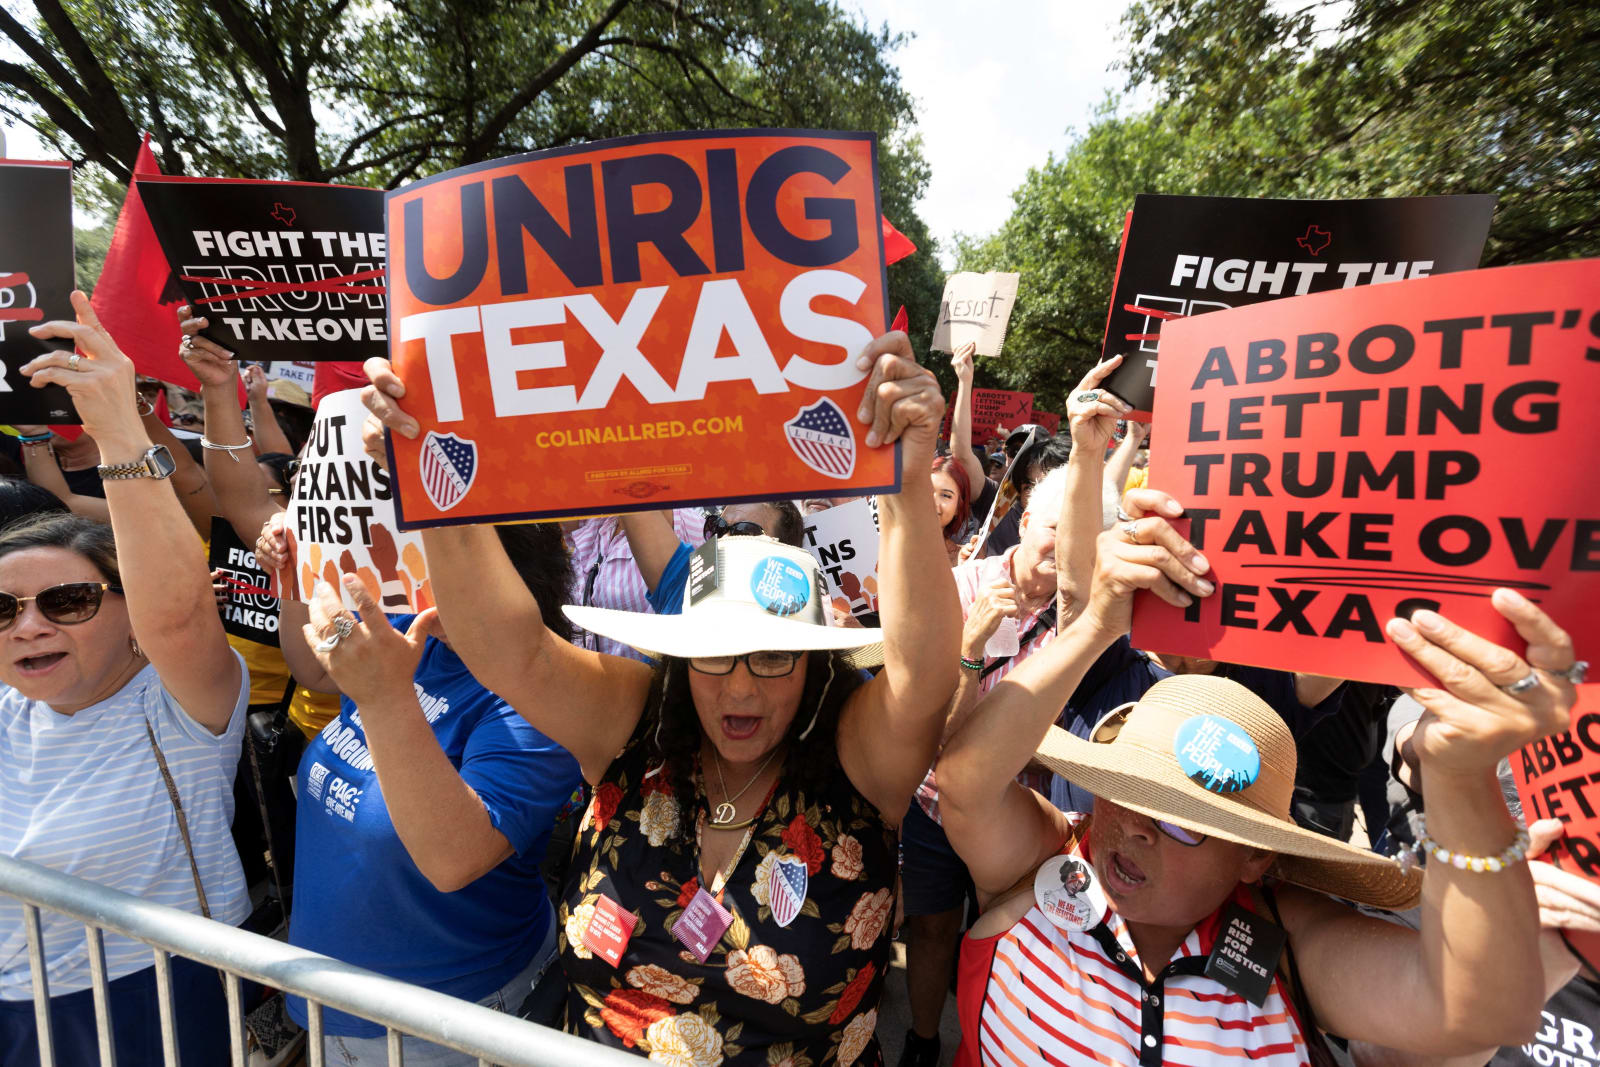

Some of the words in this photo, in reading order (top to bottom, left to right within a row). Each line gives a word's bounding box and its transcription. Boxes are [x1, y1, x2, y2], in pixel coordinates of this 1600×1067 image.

[403, 145, 860, 305] UNRIG
[192, 230, 304, 257] FIGHT
[312, 232, 386, 257] THE
[183, 264, 387, 312] TRUM
[1170, 254, 1328, 295] FIGHT
[224, 318, 388, 341] TAKEOVE
[400, 269, 874, 423] TEXAS
[280, 368, 305, 380] TAKE
[1187, 380, 1561, 442] LETTING
[307, 415, 347, 458] PUT
[535, 415, 743, 448] COLINALLRED.COM
[795, 428, 846, 447] LULAC
[292, 460, 392, 500] EXANS
[431, 443, 463, 488] LULAC
[1184, 450, 1481, 500] TRUMP
[297, 506, 374, 545] FIRST
[1183, 508, 1394, 562] TAKE
[1418, 514, 1600, 572] OVE
[228, 547, 261, 570] FIG
[766, 557, 785, 574] WE
[216, 567, 280, 611] TRU
[763, 568, 784, 588] THE
[755, 581, 796, 608] PEOPLE
[223, 604, 279, 632] TAKEO
[1194, 728, 1222, 757] THE
[1201, 717, 1227, 739] WE
[1181, 740, 1234, 784] PEOPLE
[1057, 898, 1067, 909] WE
[1228, 926, 1254, 946] RISE
[1231, 918, 1252, 934] ALL
[1224, 936, 1248, 954] FOR
[1220, 946, 1268, 978] JUSTICE
